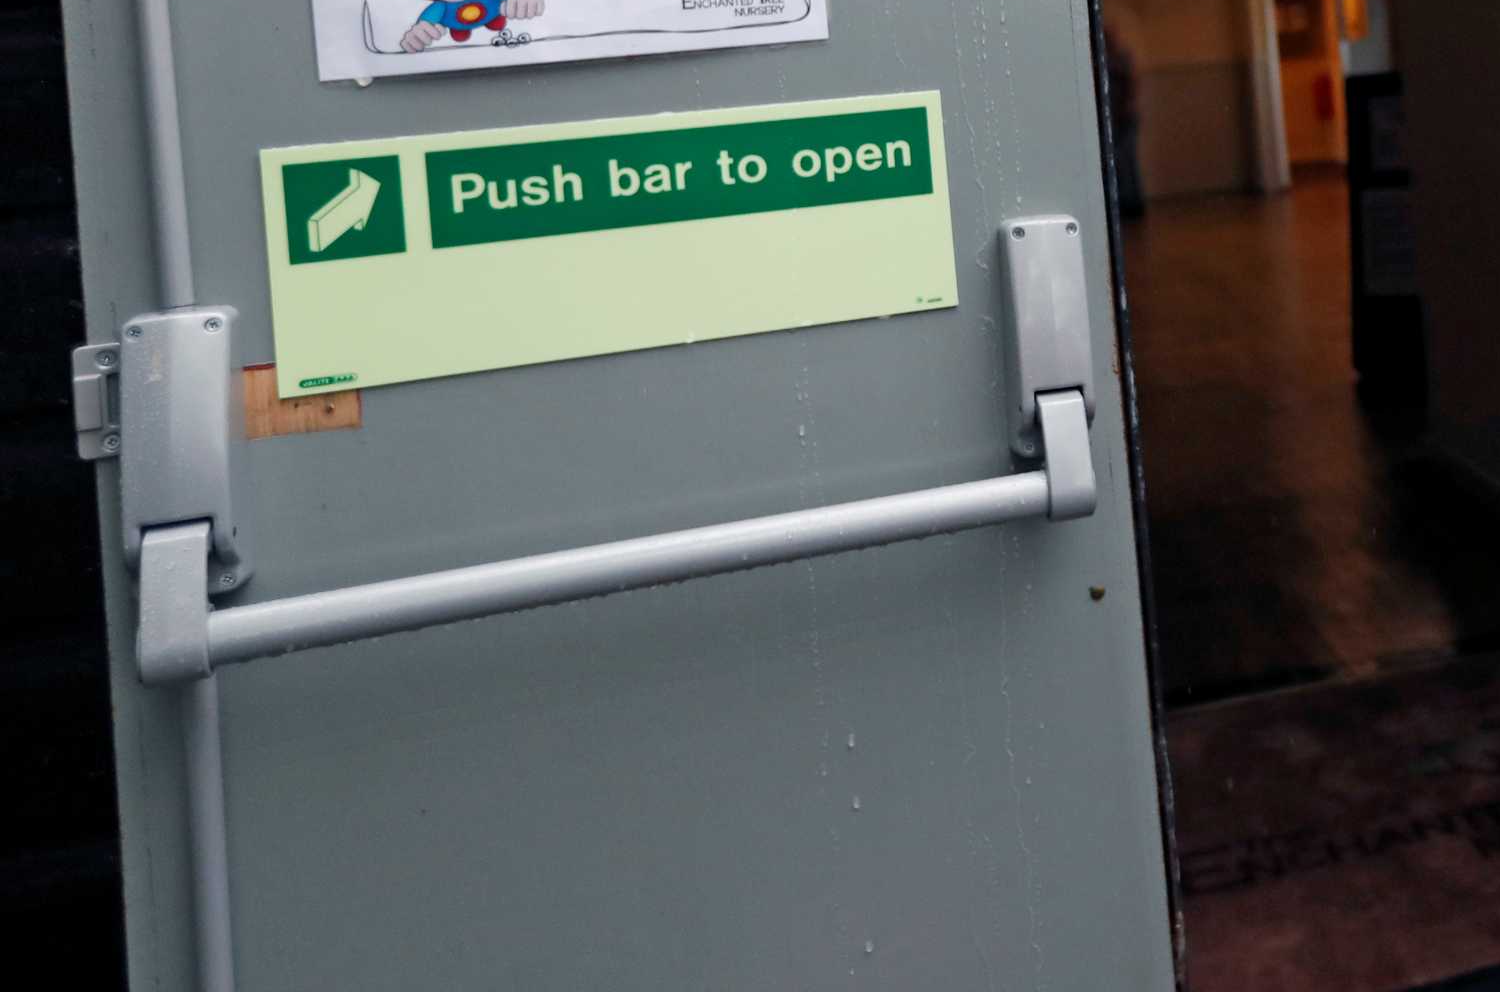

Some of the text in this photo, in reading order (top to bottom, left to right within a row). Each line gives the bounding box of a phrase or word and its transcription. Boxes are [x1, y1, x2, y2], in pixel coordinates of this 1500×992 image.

[734, 5, 785, 17] NURSERY
[450, 139, 912, 214] Push bar to open
